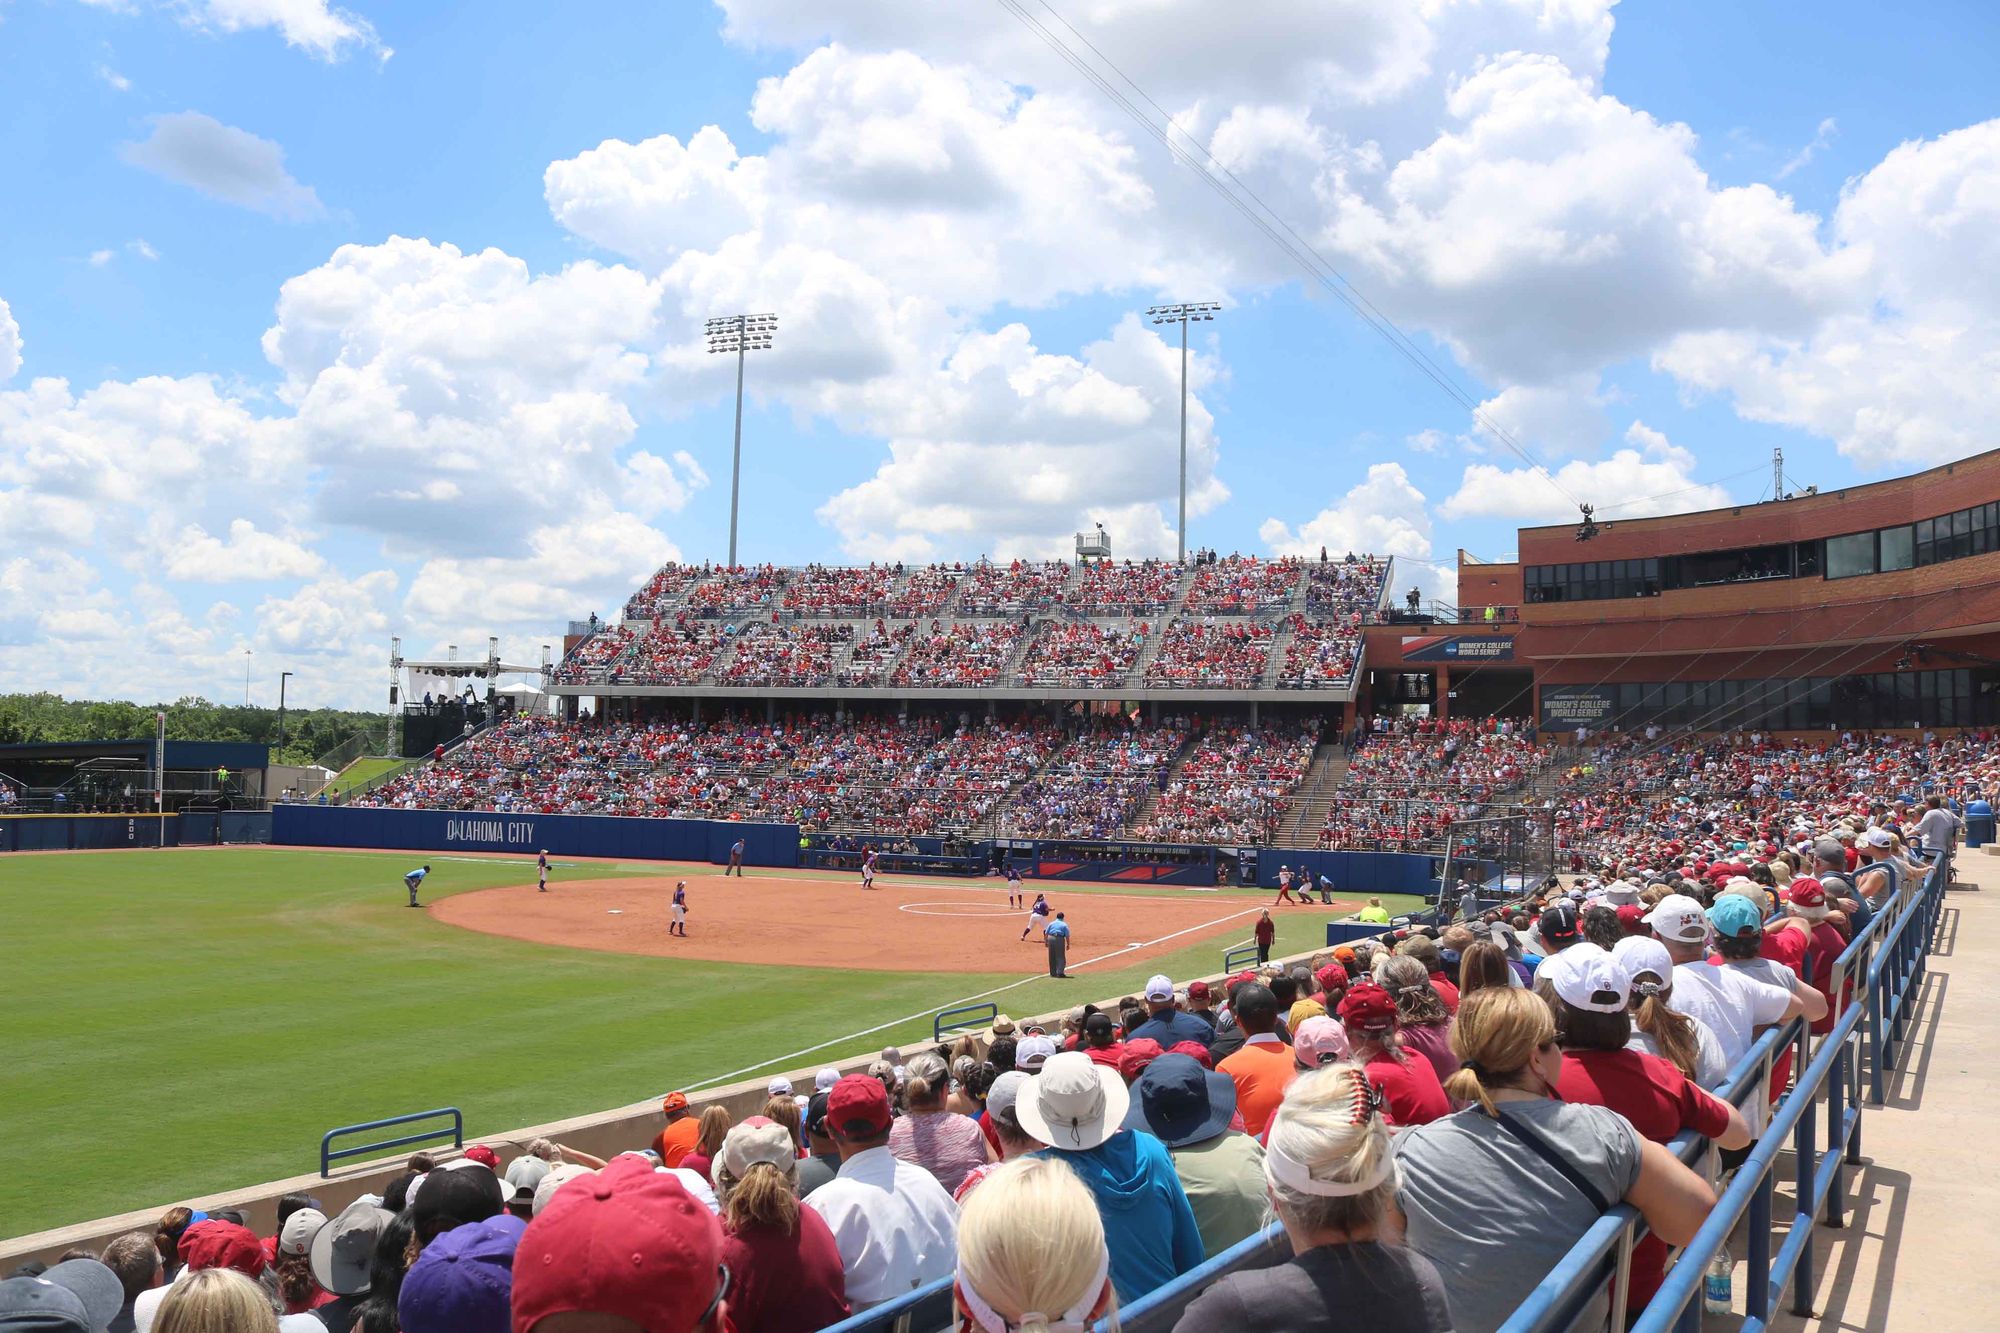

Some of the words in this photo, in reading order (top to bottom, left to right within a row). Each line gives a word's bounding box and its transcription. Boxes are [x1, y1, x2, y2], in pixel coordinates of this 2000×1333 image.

[1544, 700, 1578, 709] WOMEN'S
[1579, 700, 1611, 709] COLLEGE
[1551, 709, 1576, 717] WORLD
[1577, 709, 1603, 717] SERIES
[447, 816, 503, 842] OKLAHOMA
[508, 822, 534, 844] CITY
